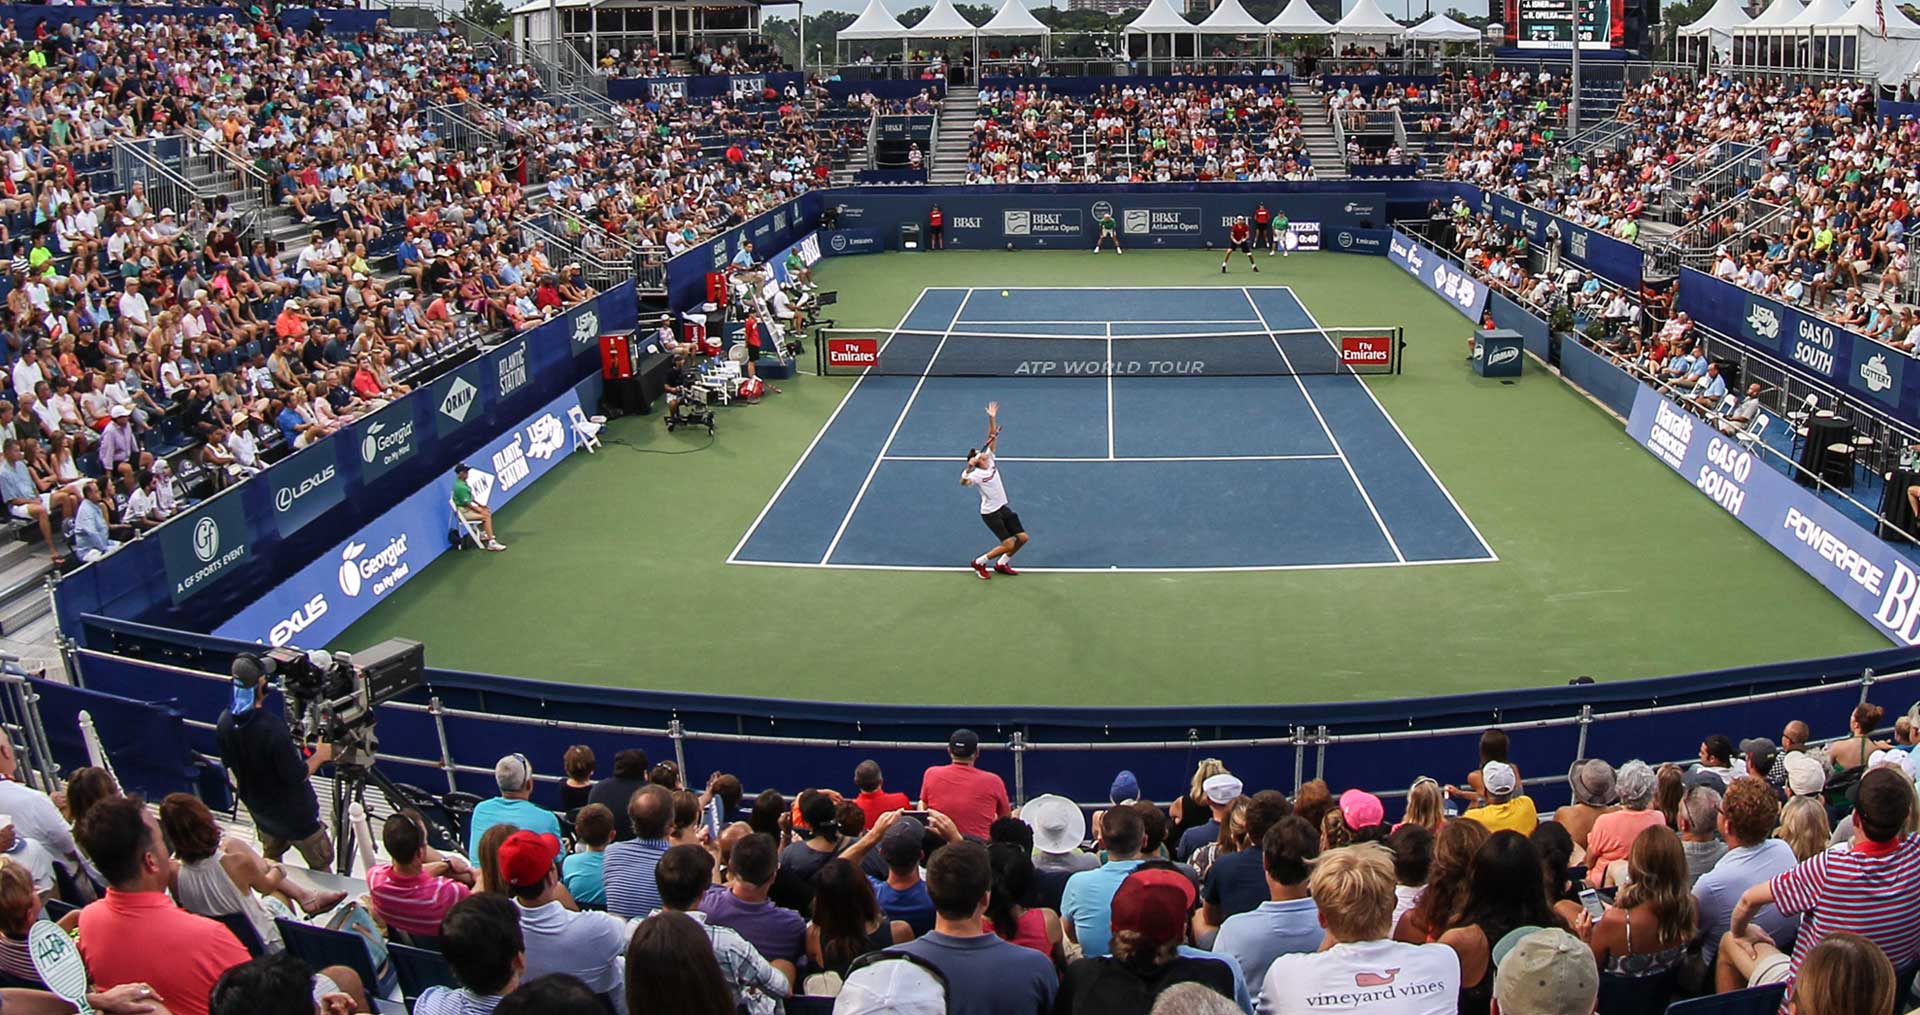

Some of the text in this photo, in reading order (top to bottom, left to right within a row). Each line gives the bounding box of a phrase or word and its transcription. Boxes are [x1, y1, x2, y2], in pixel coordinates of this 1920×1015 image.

[1588, 1, 1595, 9] 6
[1588, 13, 1595, 21] 6
[1532, 31, 1538, 40] 2
[1548, 31, 1555, 40] 3
[953, 217, 981, 229] BB&T
[1032, 213, 1061, 225] BB&T
[1060, 223, 1080, 233] Open
[1152, 212, 1180, 224] BB&T
[1179, 222, 1199, 232] Open
[1299, 234, 1319, 243] 0:49
[1799, 320, 1822, 345] GAS
[830, 350, 876, 362] Emirates
[845, 343, 861, 353] Fly
[1343, 350, 1388, 361] Emirates
[1359, 342, 1373, 351] Fly
[499, 348, 526, 377] ATLANTIC
[1014, 361, 1205, 375] ATP WORLD TOUR
[1794, 341, 1834, 375] SOUTH
[499, 364, 527, 397] STATION
[1861, 366, 1891, 387] LOTTERY
[445, 386, 472, 415] ORKIN
[377, 421, 413, 452] Georgia
[492, 441, 524, 473] ATLANTIC
[1707, 437, 1738, 473] GAS
[291, 464, 336, 499] LEXUS
[498, 455, 531, 491] STATION
[1696, 465, 1746, 516] SOUTH
[359, 537, 408, 579] Georgia
[177, 582, 185, 594] A
[194, 559, 222, 583] SPORTS
[222, 544, 245, 566] EVENT
[1306, 980, 1446, 1007] vineyard vines
